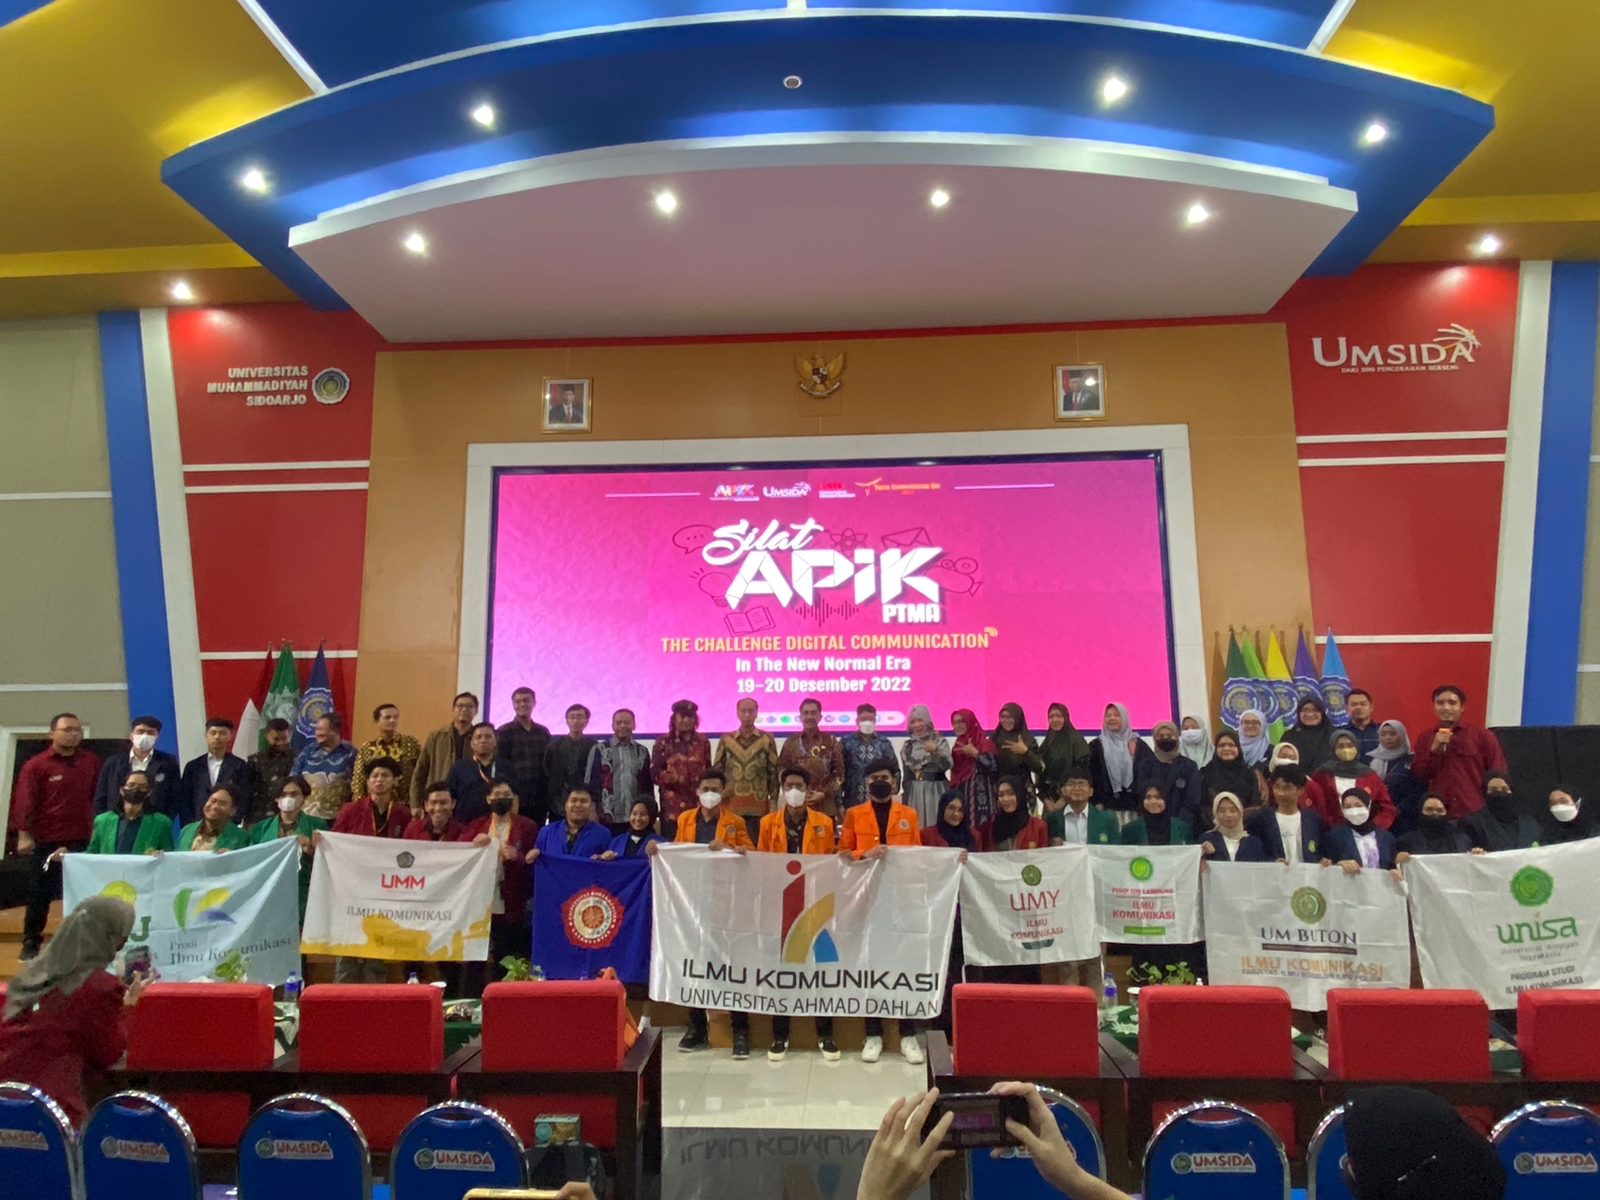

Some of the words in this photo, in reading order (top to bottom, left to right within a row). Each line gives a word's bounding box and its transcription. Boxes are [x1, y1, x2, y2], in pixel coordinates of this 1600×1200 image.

[1312, 336, 1476, 367] UMSIDA
[228, 366, 308, 379] UNIVERSITAS
[207, 380, 308, 393] MUHAMMADIYAH
[246, 395, 307, 406] SIDOARJO
[702, 518, 824, 565] Silat
[882, 604, 940, 623] PTMA
[661, 637, 690, 653] THE
[694, 636, 781, 652] CHALLENGE
[786, 635, 846, 650] DIGITAL
[850, 632, 989, 649] COMMUNICATION
[735, 657, 751, 672] In
[755, 657, 783, 672] The
[786, 657, 819, 671] New
[824, 656, 881, 670] Normal
[885, 656, 911, 671] Era
[788, 677, 867, 692] Desember
[871, 677, 911, 692] 2022
[381, 873, 425, 889] UMM
[1010, 890, 1060, 911] UMY
[1132, 901, 1155, 909] ILMU
[347, 906, 374, 918] ILMU
[377, 909, 452, 921] KOMUNIKASI
[1112, 911, 1175, 920] KOMUNIKASI
[1026, 919, 1048, 928] ILMU
[1011, 927, 1064, 939] KOMUNIKASI
[1261, 928, 1291, 941] UM
[170, 941, 198, 951] Prodi
[170, 952, 204, 965] Ilmu
[208, 937, 292, 961] Kounikasi
[1241, 957, 1281, 969] ILMU
[1286, 959, 1384, 976] KOMUNIKASI
[1510, 971, 1550, 980] PROGRAM
[1551, 966, 1575, 976] STUDI
[682, 958, 747, 985] ILMU
[755, 969, 939, 992] KOMUNIKASI
[680, 987, 788, 1013] UNIVERSITAS
[793, 998, 860, 1014] AHMAD
[865, 998, 938, 1016] DAHLAN
[119, 1143, 167, 1156] UMSIDA
[276, 1142, 331, 1154] UMSIDA
[436, 1154, 493, 1165] UMSIDA
[1193, 1156, 1253, 1166] UMSIDA
[1535, 1156, 1595, 1166] UMSIDA
